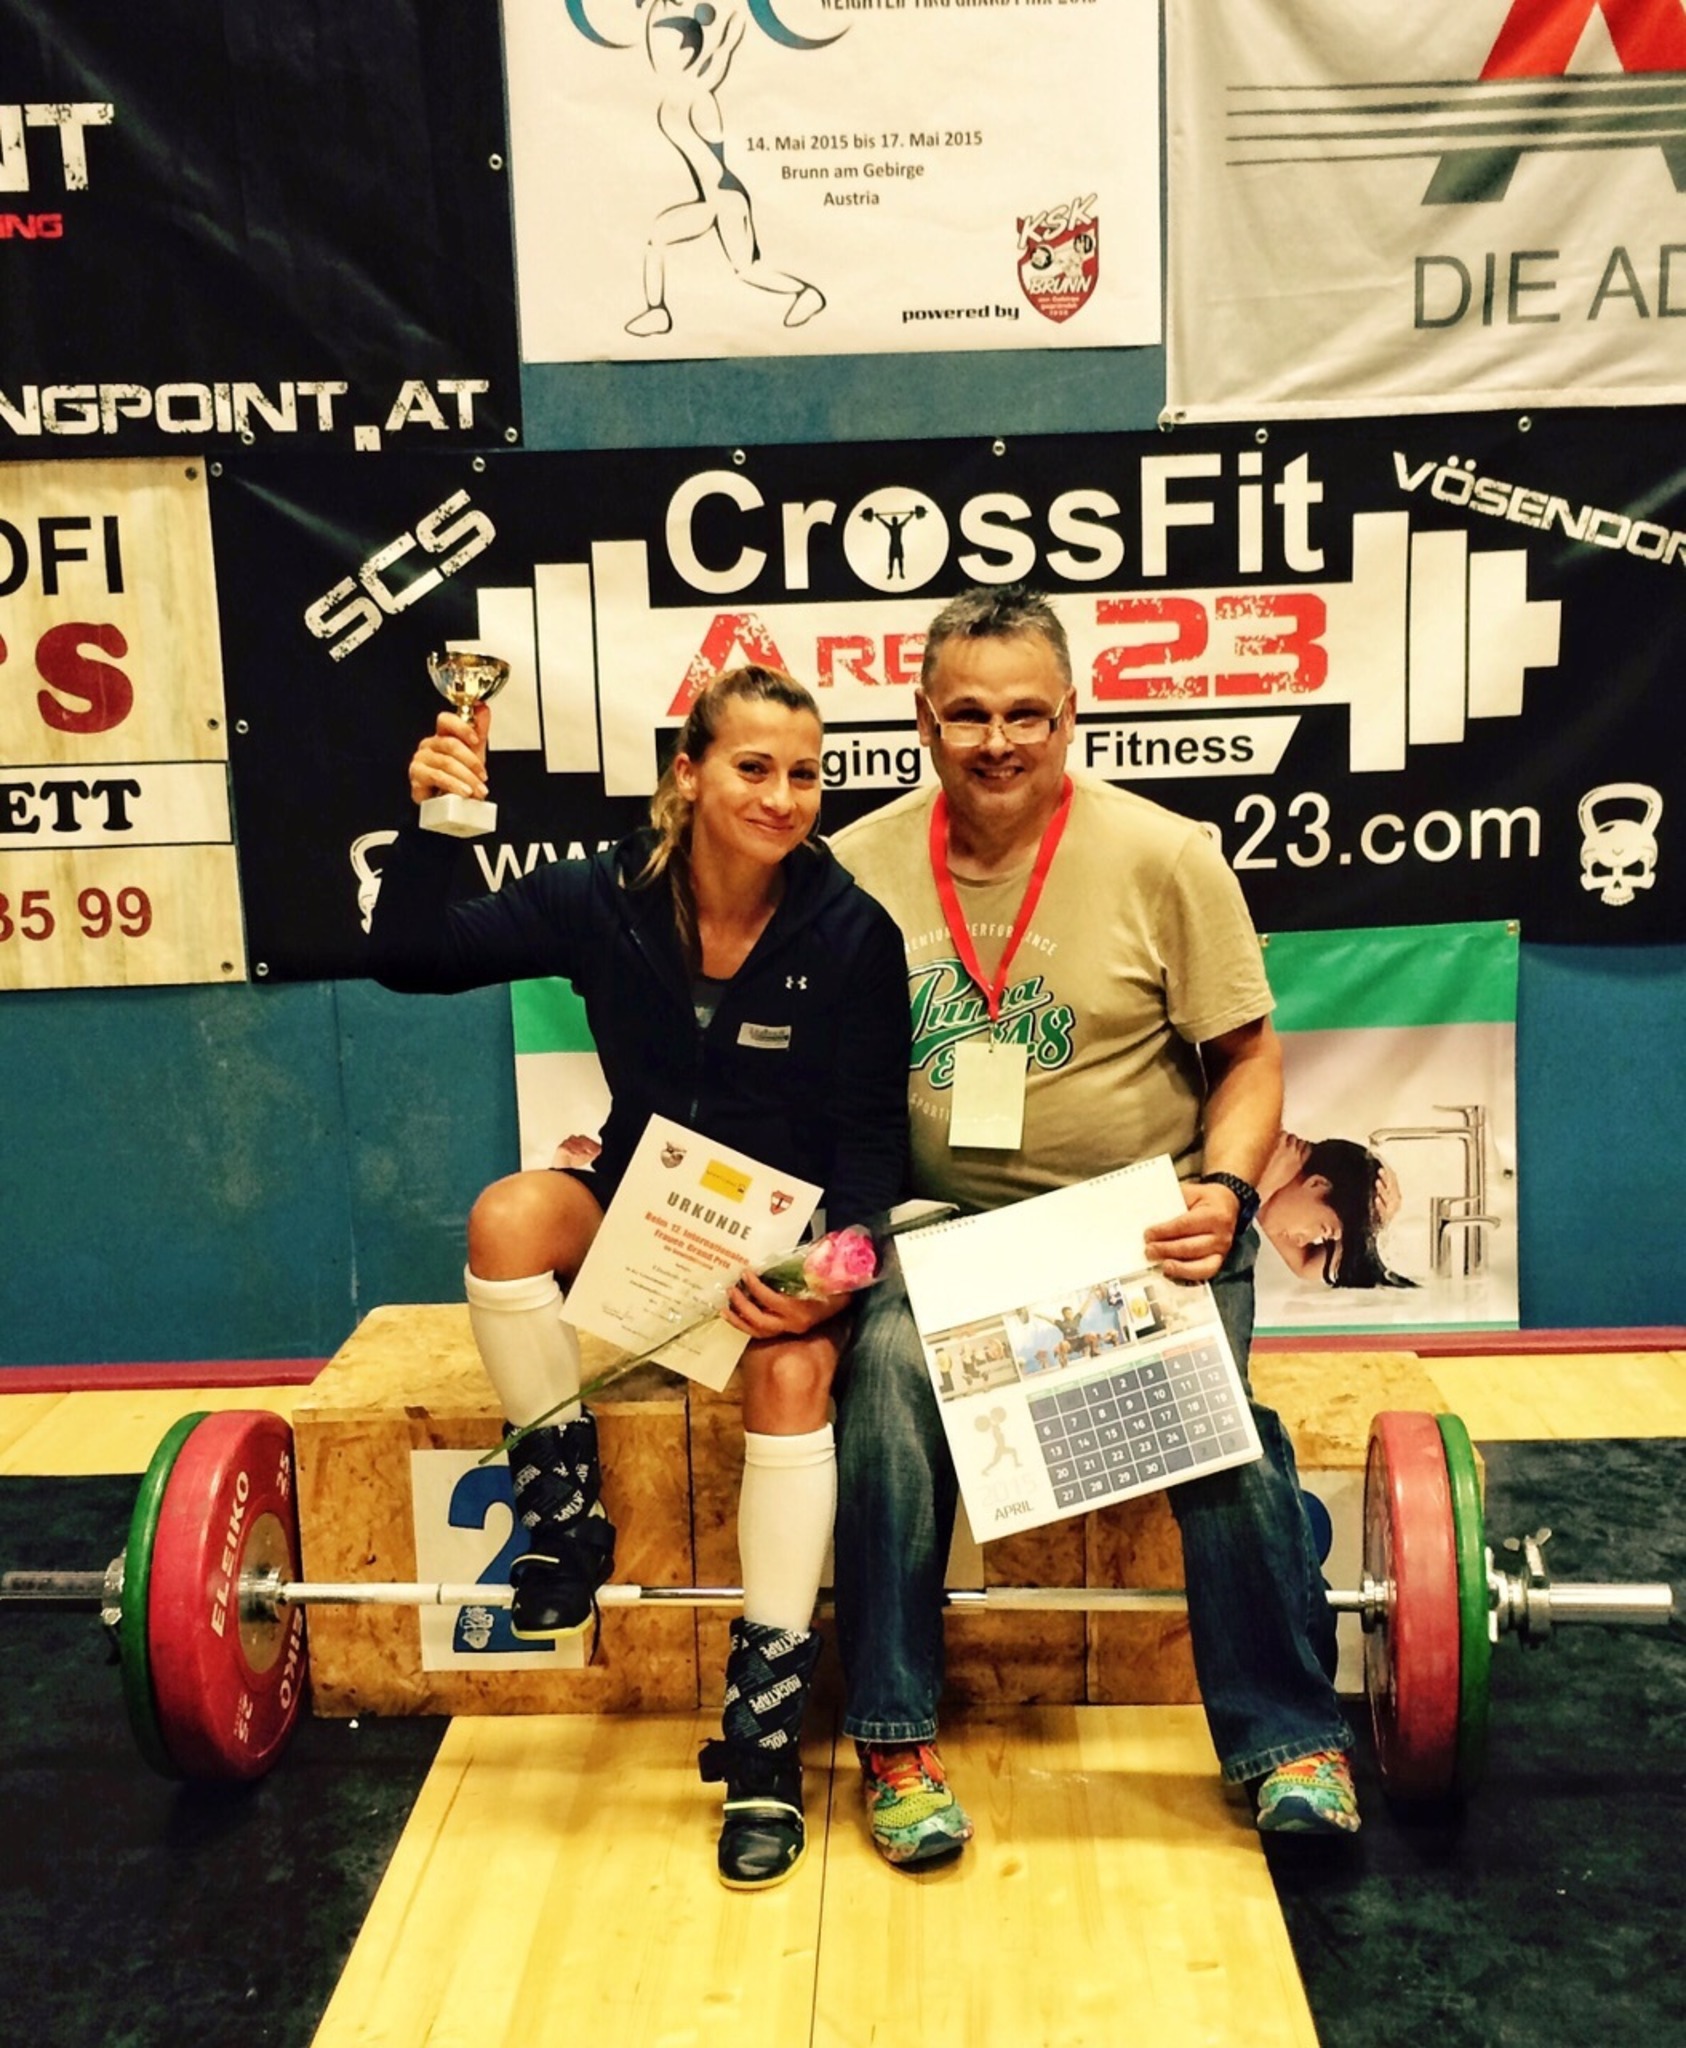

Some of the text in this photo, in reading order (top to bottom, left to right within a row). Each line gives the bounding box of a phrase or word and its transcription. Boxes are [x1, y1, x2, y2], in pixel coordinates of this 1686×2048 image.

[747, 130, 983, 152] 14. Mai 2015 bis 17. Mai 2015
[781, 161, 925, 180] Brunn am Gebirge
[823, 190, 880, 207] Austria
[1017, 192, 1098, 251] KSK
[1029, 275, 1092, 295] BRUNN
[1413, 249, 1561, 330] DIE
[902, 304, 1020, 324] powered by
[304, 488, 497, 663] SCS
[1092, 592, 1329, 702] 23
[1085, 730, 1255, 770] Fitness
[77, 886, 153, 939] 99
[667, 1191, 752, 1240] URKUNDE
[654, 1228, 685, 1248] Frauen
[687, 1243, 713, 1260] Grand
[713, 1256, 731, 1269] Prix
[1120, 1378, 1127, 1388] 2
[1146, 1369, 1154, 1379] 3
[1043, 1425, 1051, 1436] 6
[1071, 1418, 1077, 1427] 7
[1098, 1408, 1106, 1418] 8
[1126, 1400, 1134, 1410] 9
[1153, 1389, 1166, 1400] 10
[1180, 1380, 1192, 1391] 11
[1050, 1446, 1062, 1457] 13
[1078, 1438, 1090, 1448] 14
[1105, 1428, 1118, 1439] 15
[1132, 1419, 1146, 1430] 16
[1160, 1410, 1171, 1421] 17
[1056, 1414, 1234, 1479] 20 21 22 23 24 25 26
[1062, 1489, 1074, 1501] 27
[1089, 1481, 1103, 1492] 28
[1118, 1472, 1131, 1484] 29
[1146, 1462, 1159, 1474] 30
[994, 1499, 1036, 1521] APRIL
[210, 1470, 249, 1638] ELEIKO
[748, 1673, 803, 1715] ROCKTAPE
